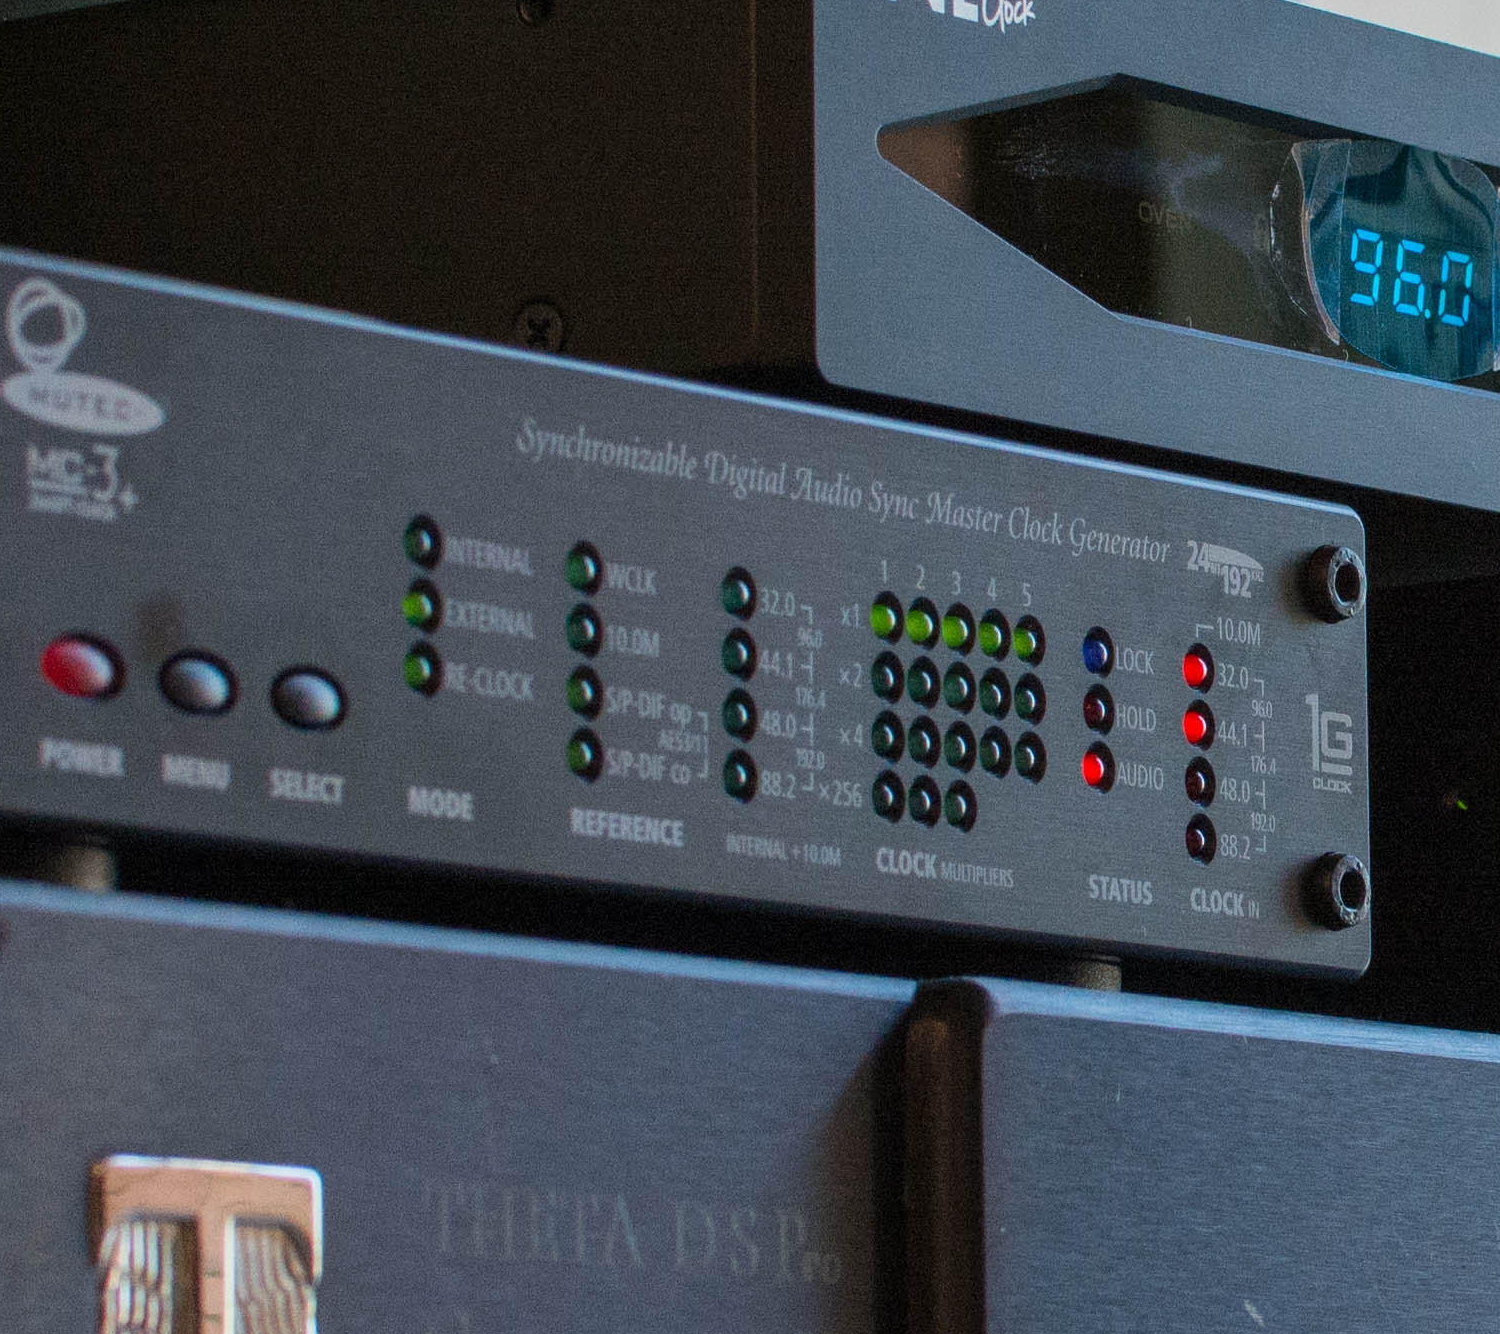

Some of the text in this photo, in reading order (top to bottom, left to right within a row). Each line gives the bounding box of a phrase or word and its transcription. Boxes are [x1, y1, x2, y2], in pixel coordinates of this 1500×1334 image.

[1350, 228, 1474, 327] 96.0
[516, 416, 1171, 563] Synchronizable Digital Audio Sync Master Clock Generator
[443, 535, 534, 577] INTERNAL
[881, 559, 1031, 607] 1 2 3 4 5
[760, 587, 796, 617] 32.0
[442, 597, 536, 640] EXTERNAL
[1216, 616, 1262, 646] 10.0M
[760, 650, 793, 679] 44.1
[1114, 645, 1155, 676] LOCK
[443, 661, 534, 702] RE-CLOCK
[1217, 662, 1250, 691] 32.0
[760, 709, 797, 740] 48.0
[1116, 704, 1157, 733] HOLD
[1217, 719, 1248, 748] 44.1
[38, 736, 345, 806] POWER MENU SELECT
[760, 769, 797, 799] 88.2
[1116, 761, 1164, 791] AUDIO
[406, 784, 474, 823] MODE
[1219, 777, 1251, 804] 48.0
[569, 806, 685, 848] REFERENCE
[1219, 833, 1251, 860] 88.2
[875, 846, 1015, 889] CLOCK MULTIPLIERS
[1088, 874, 1154, 906] STATUS
[1190, 887, 1245, 918] CLOCK
